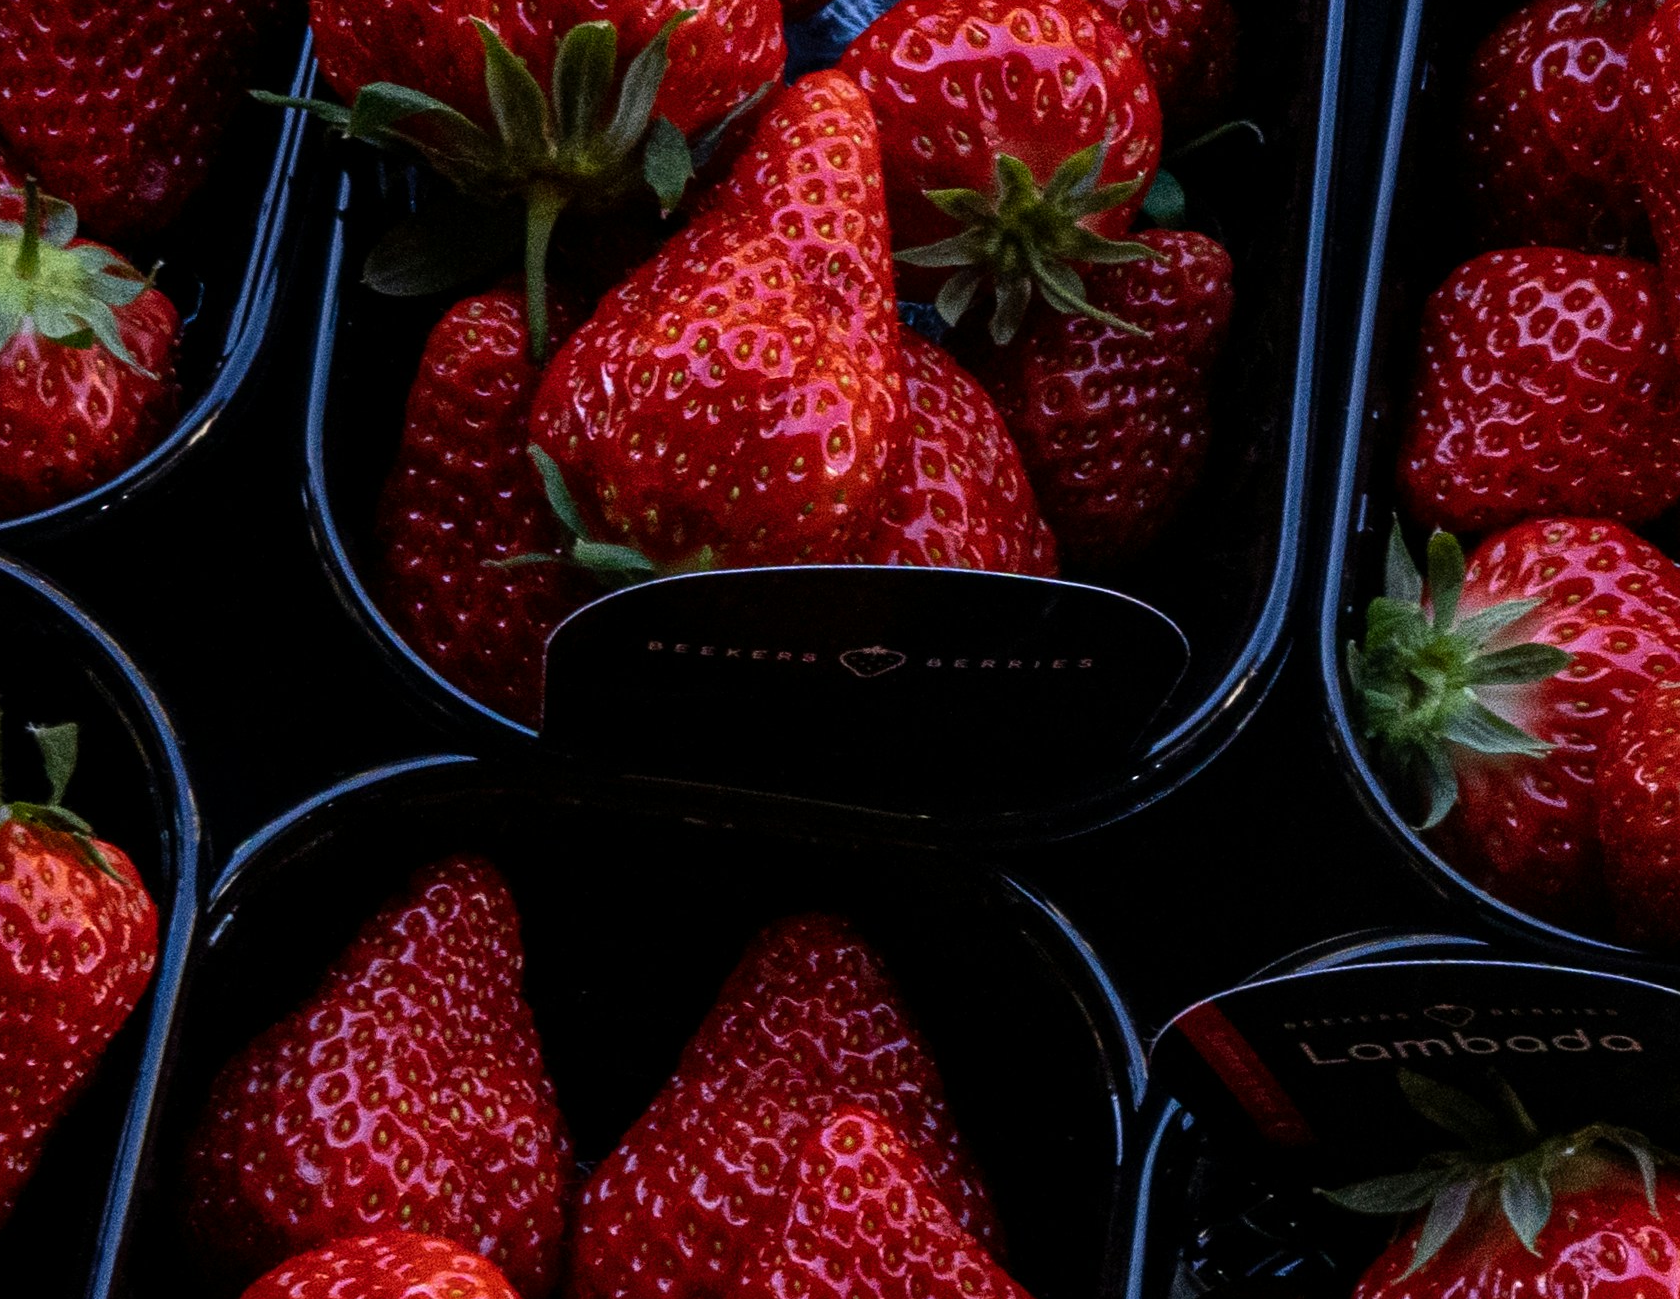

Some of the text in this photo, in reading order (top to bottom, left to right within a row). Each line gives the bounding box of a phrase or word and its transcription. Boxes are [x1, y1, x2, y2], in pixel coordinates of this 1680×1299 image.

[646, 640, 1094, 670] BEEKERS BERRIES
[1298, 1027, 1645, 1067] Lambada
